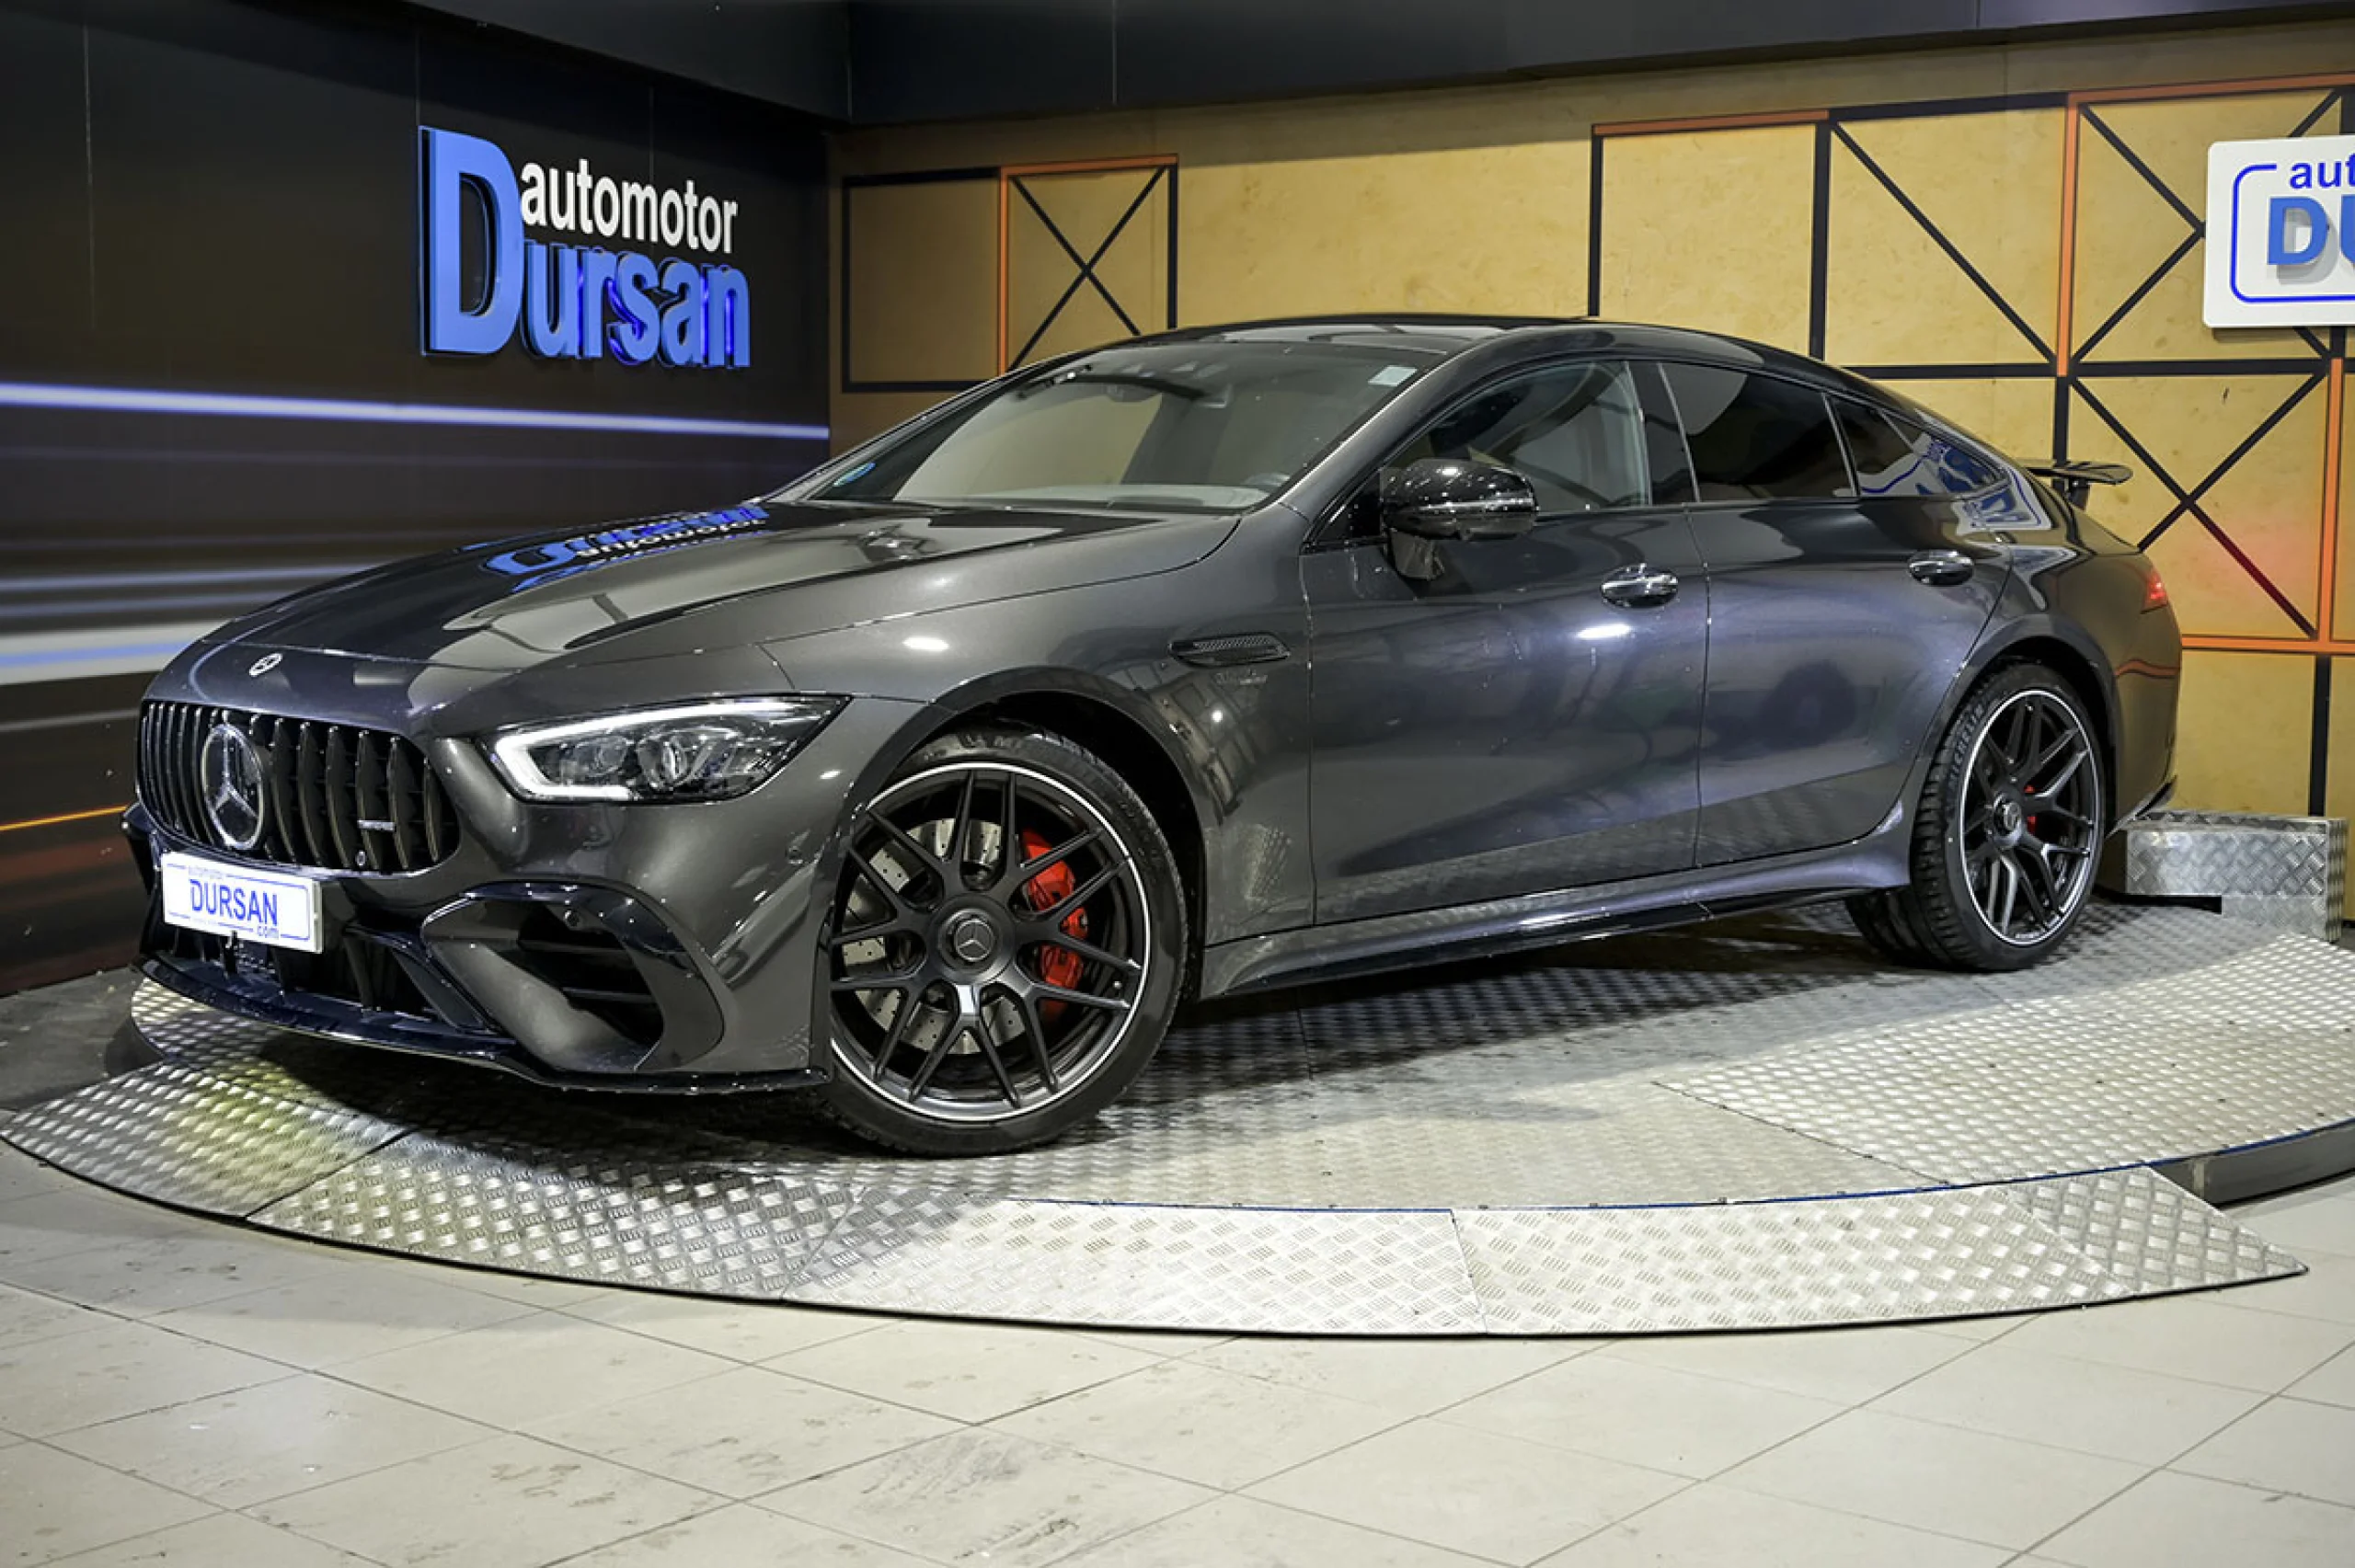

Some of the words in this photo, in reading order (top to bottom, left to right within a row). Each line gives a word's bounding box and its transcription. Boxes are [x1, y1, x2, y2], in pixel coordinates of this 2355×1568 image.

[419, 125, 751, 369] Dursan
[521, 158, 738, 253] automotor
[2266, 194, 2355, 267] D
[189, 878, 278, 927] DURSAN
